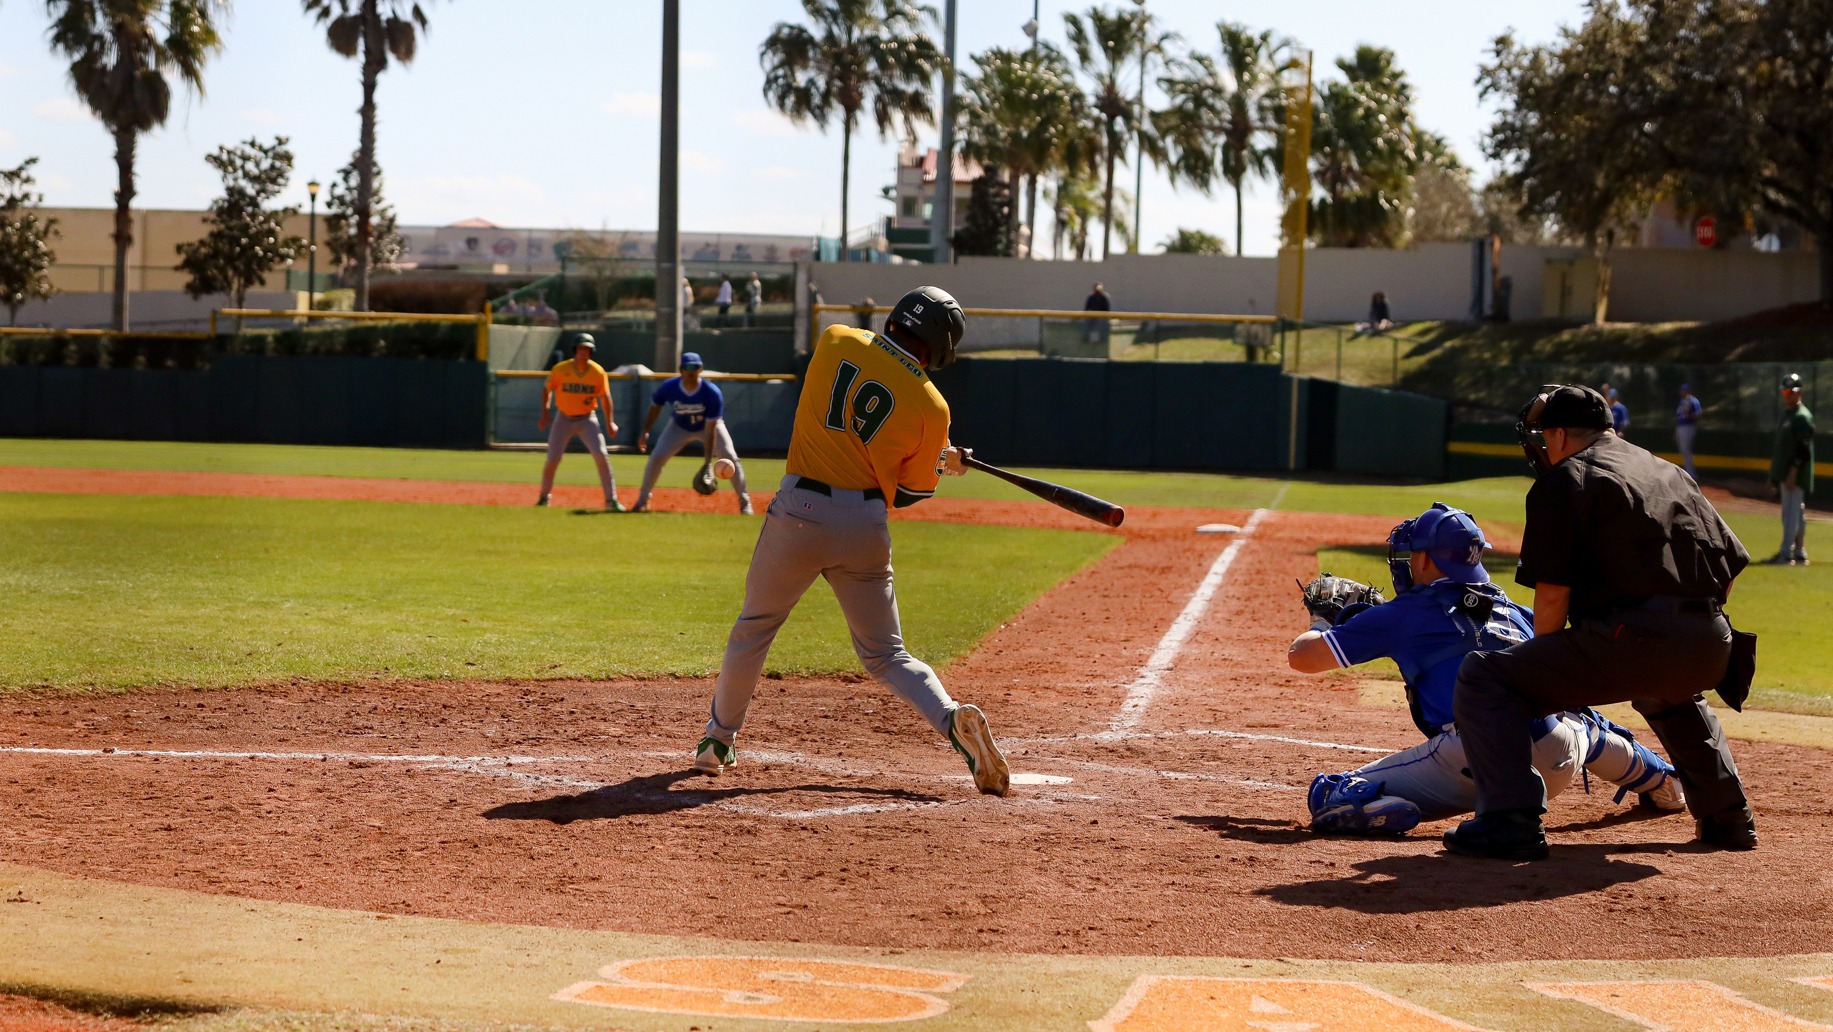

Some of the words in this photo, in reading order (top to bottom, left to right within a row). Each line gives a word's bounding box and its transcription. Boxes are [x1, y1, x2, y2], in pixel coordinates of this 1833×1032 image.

[912, 303, 924, 314] 19
[562, 382, 596, 394] LIONS
[825, 358, 896, 445] 19
